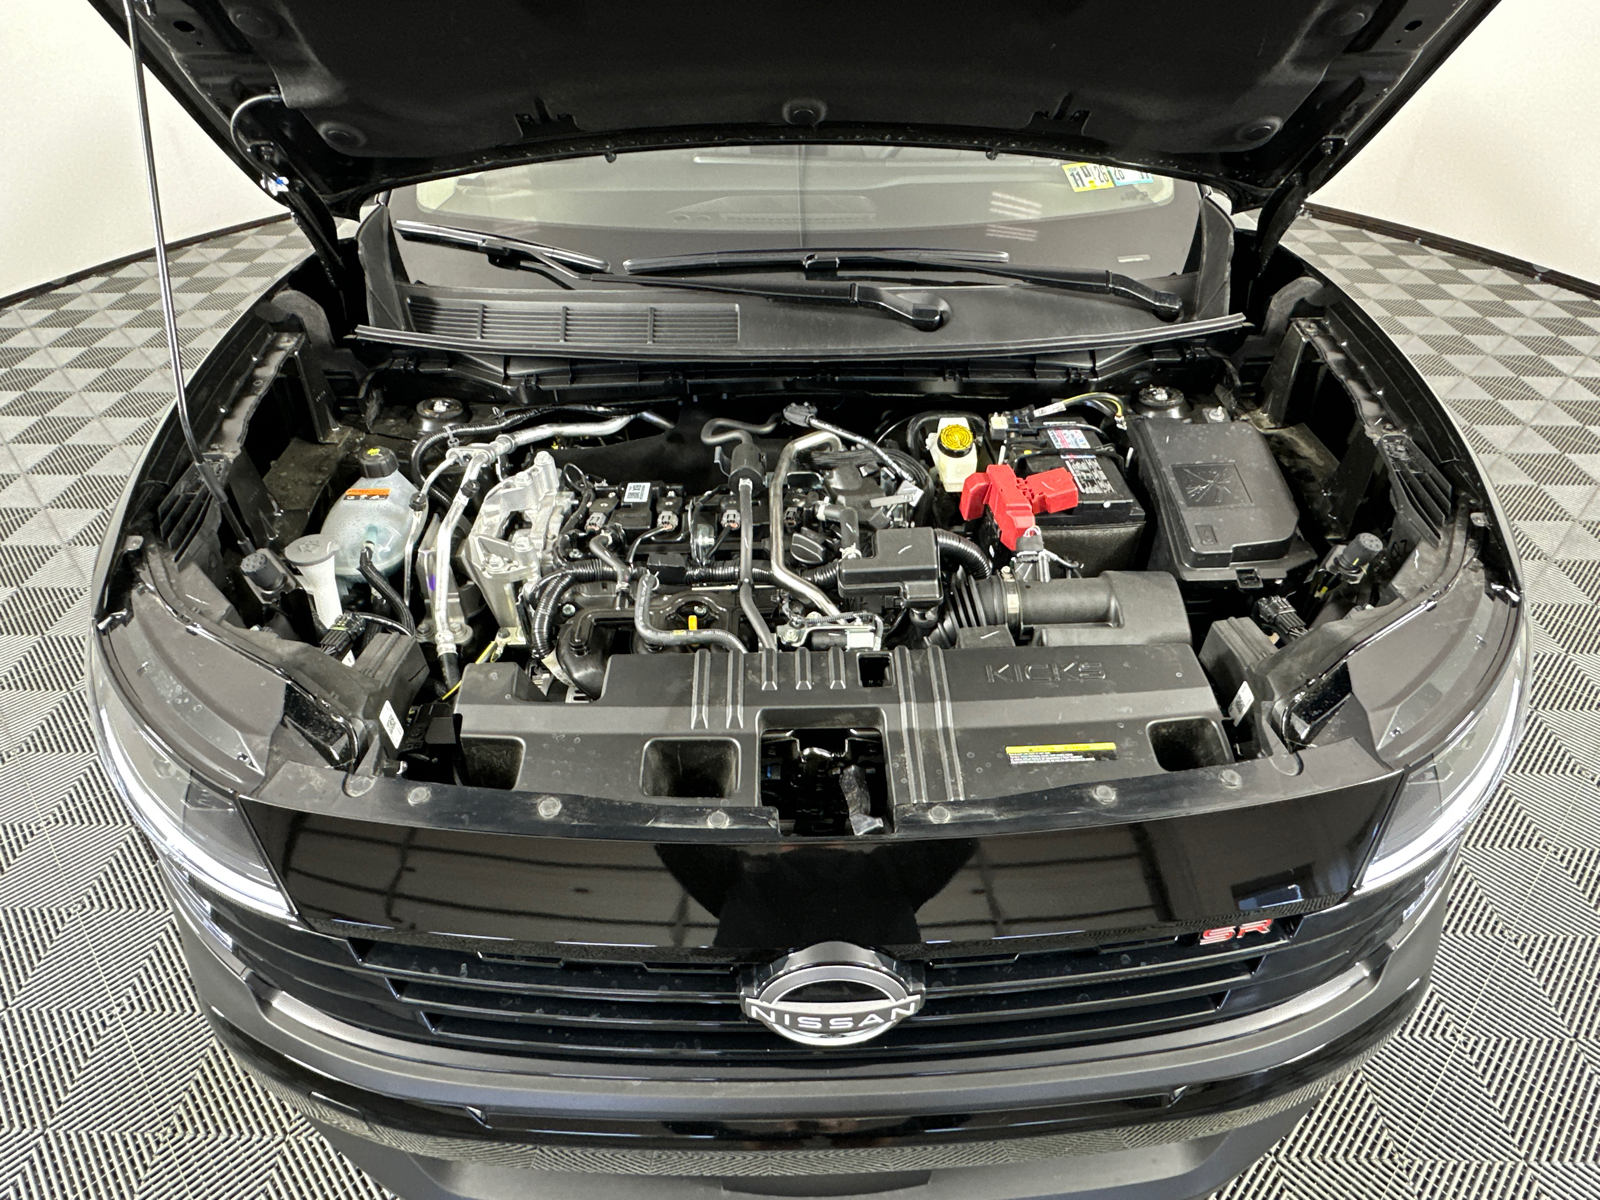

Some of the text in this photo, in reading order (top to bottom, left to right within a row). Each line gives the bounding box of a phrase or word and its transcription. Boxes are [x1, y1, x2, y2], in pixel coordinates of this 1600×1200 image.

[1070, 165, 1110, 187] 11 26
[985, 662, 1106, 683] KICKS
[1199, 918, 1272, 945] SR
[750, 1002, 915, 1029] NISSAN
